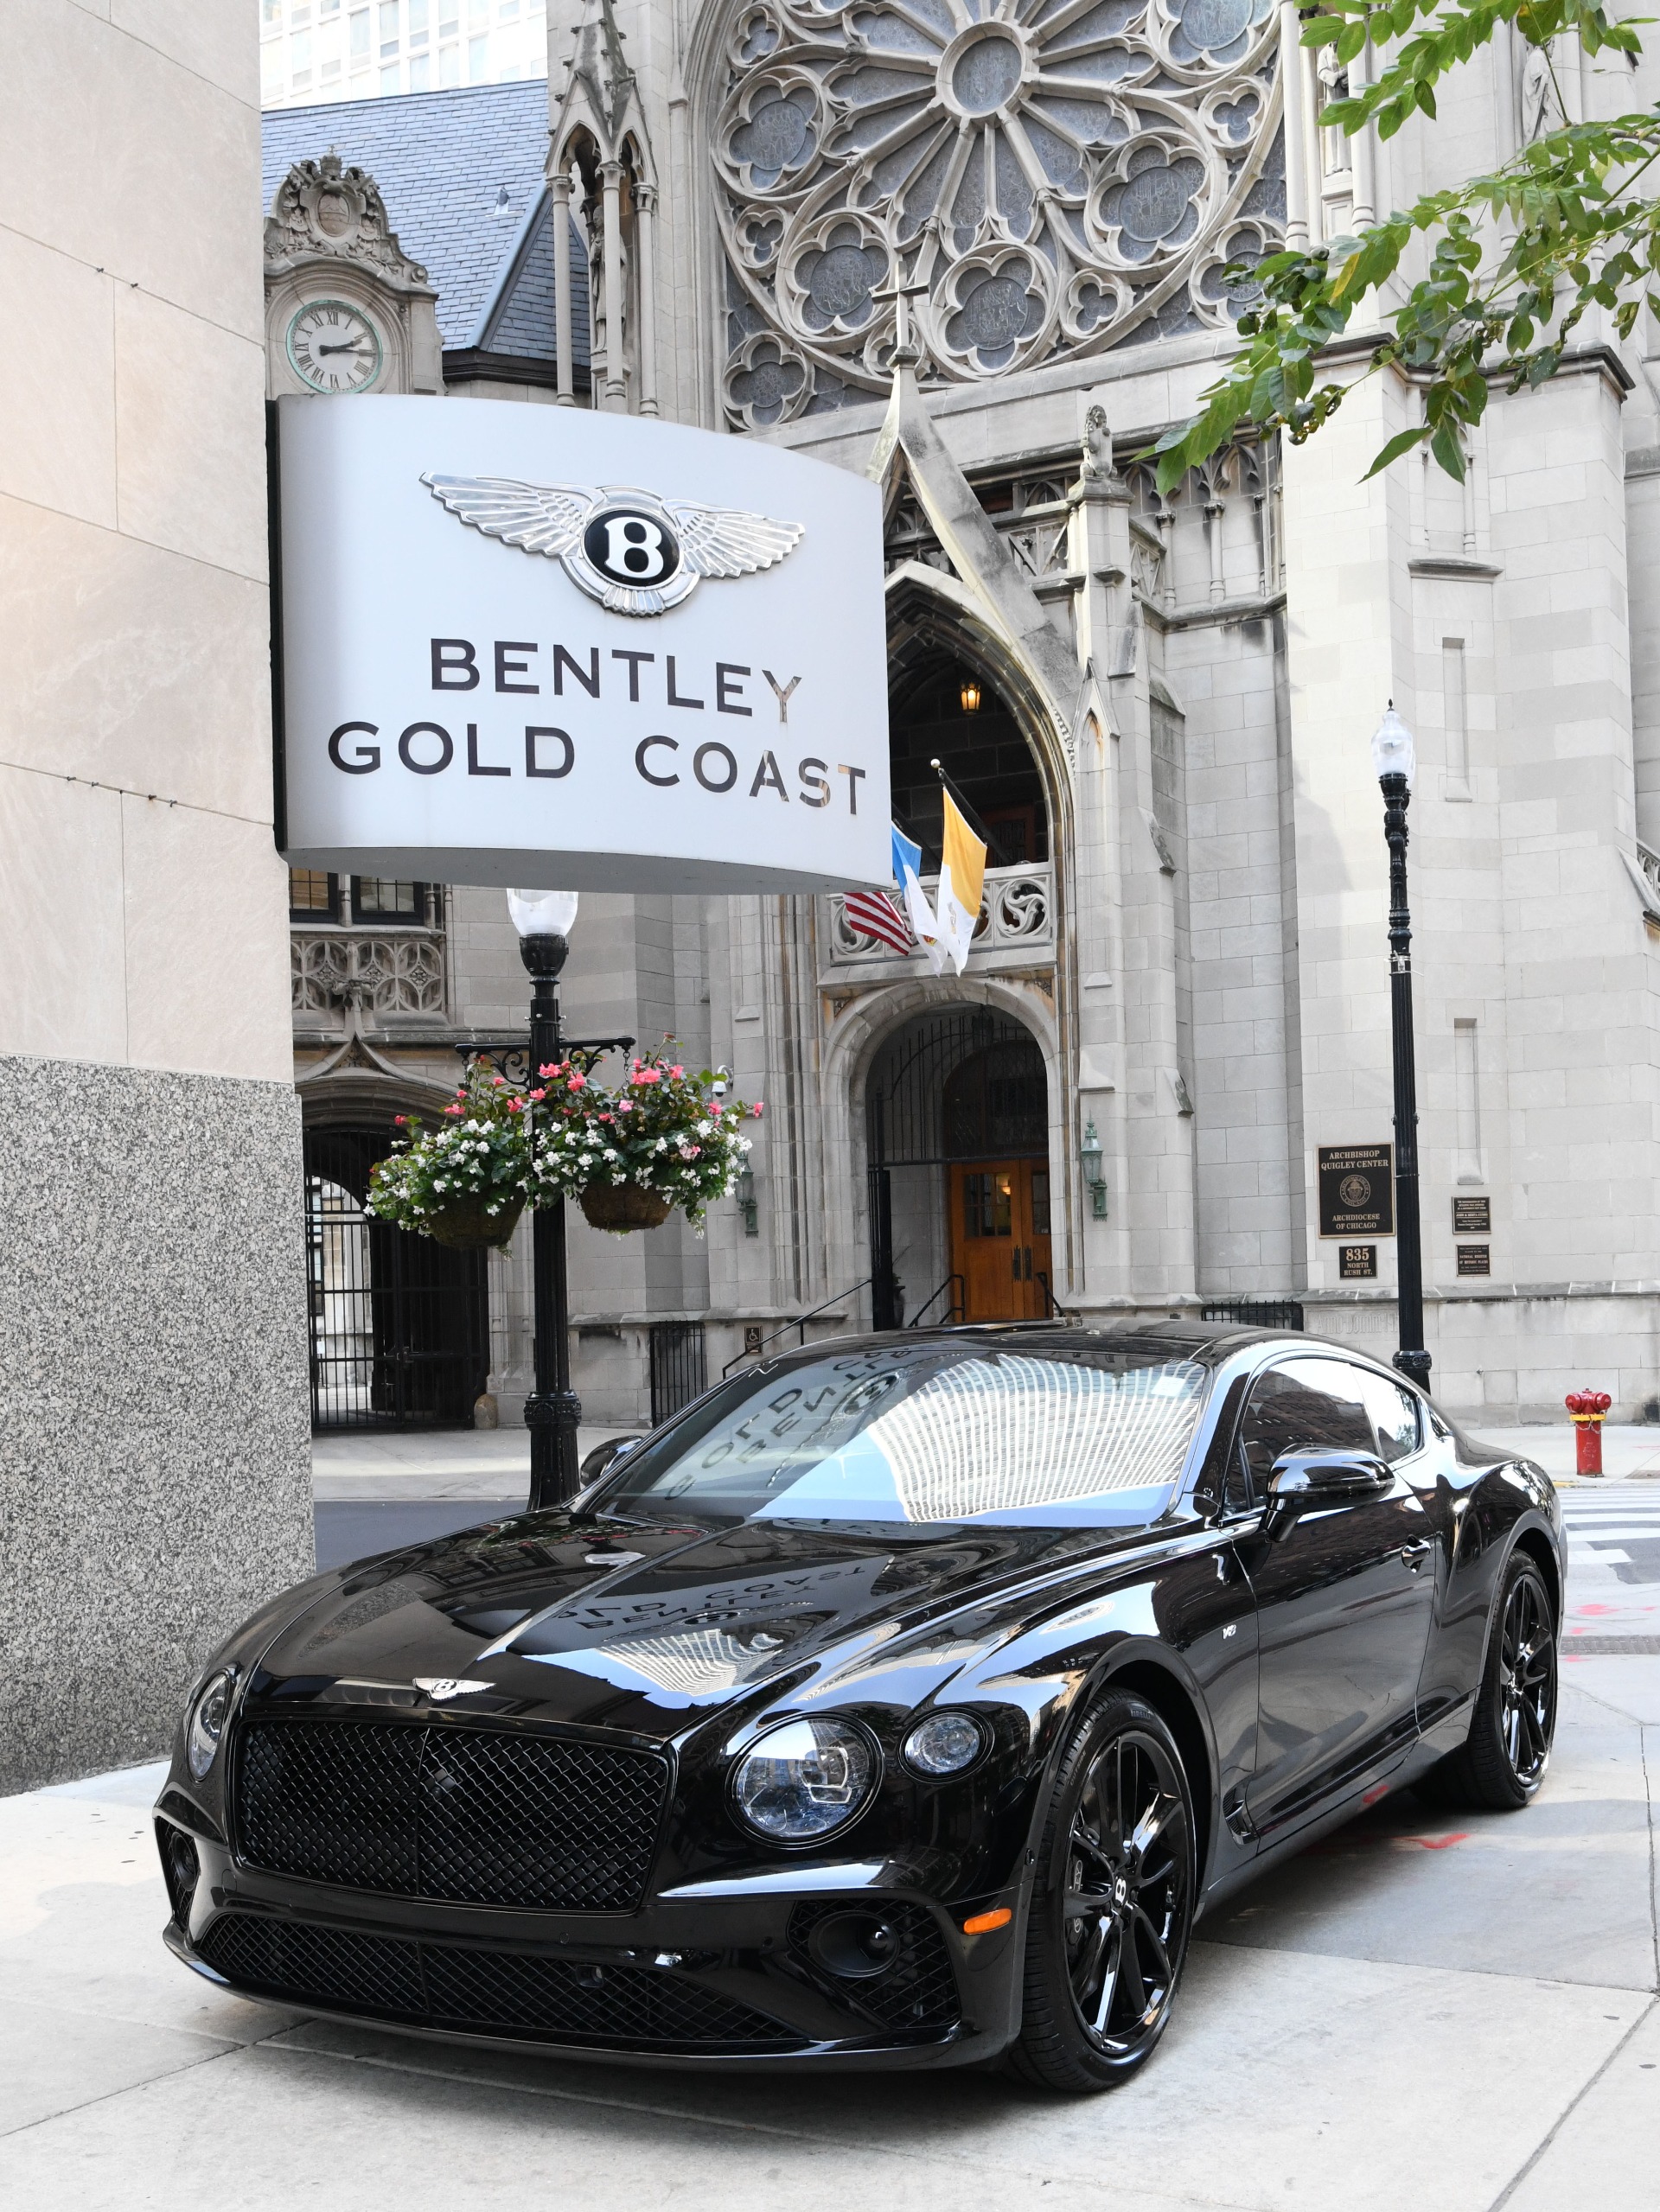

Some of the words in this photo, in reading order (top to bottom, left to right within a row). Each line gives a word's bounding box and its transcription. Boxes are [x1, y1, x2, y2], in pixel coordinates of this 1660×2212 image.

[605, 516, 664, 580] B
[431, 638, 802, 723] BENTLEY
[328, 721, 575, 779] GOLD
[635, 735, 866, 815] COAST
[1321, 1161, 1356, 1170] QUIGLEY
[1357, 1159, 1389, 1168] CENTER
[1329, 1151, 1380, 1160] ARCHBISHOP
[1346, 1248, 1370, 1261] 835
